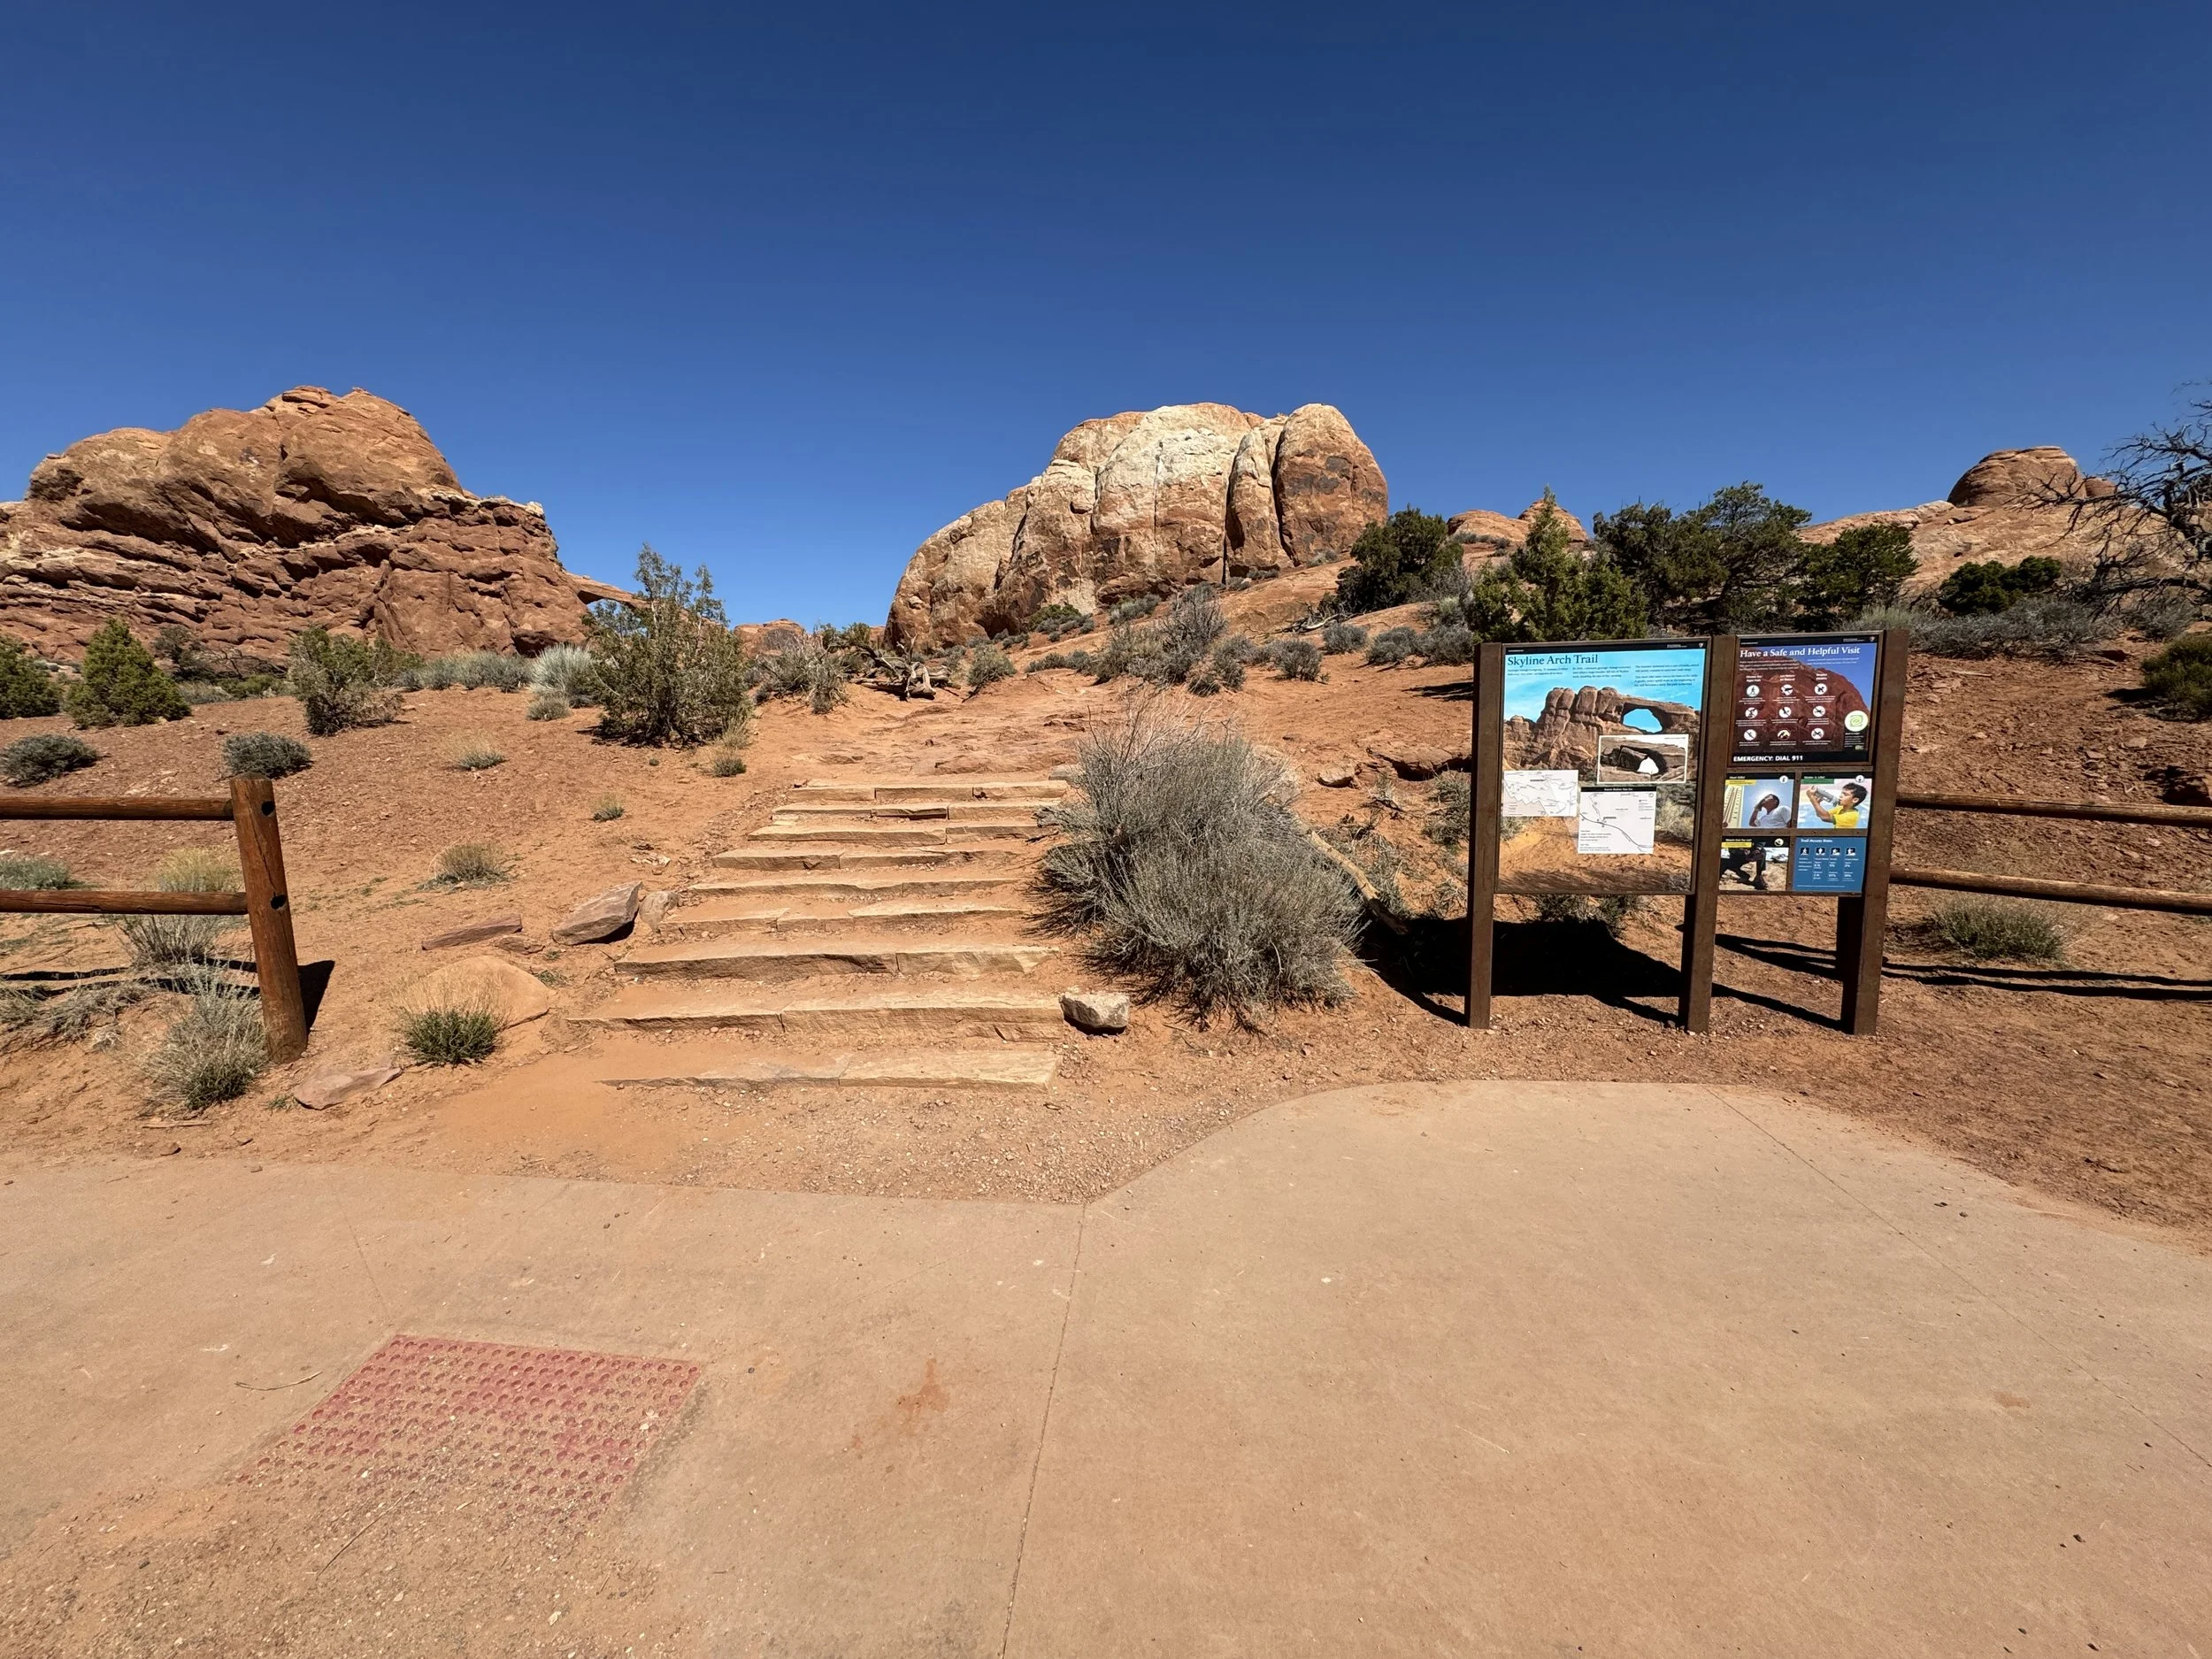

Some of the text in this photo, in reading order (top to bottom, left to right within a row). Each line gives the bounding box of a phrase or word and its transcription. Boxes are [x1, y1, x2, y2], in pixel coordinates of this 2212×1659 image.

[1789, 648, 1805, 657] and
[1808, 647, 1839, 657] Helpful
[1841, 646, 1861, 655] Visit
[1507, 654, 1598, 668] Skyline Arch Trail
